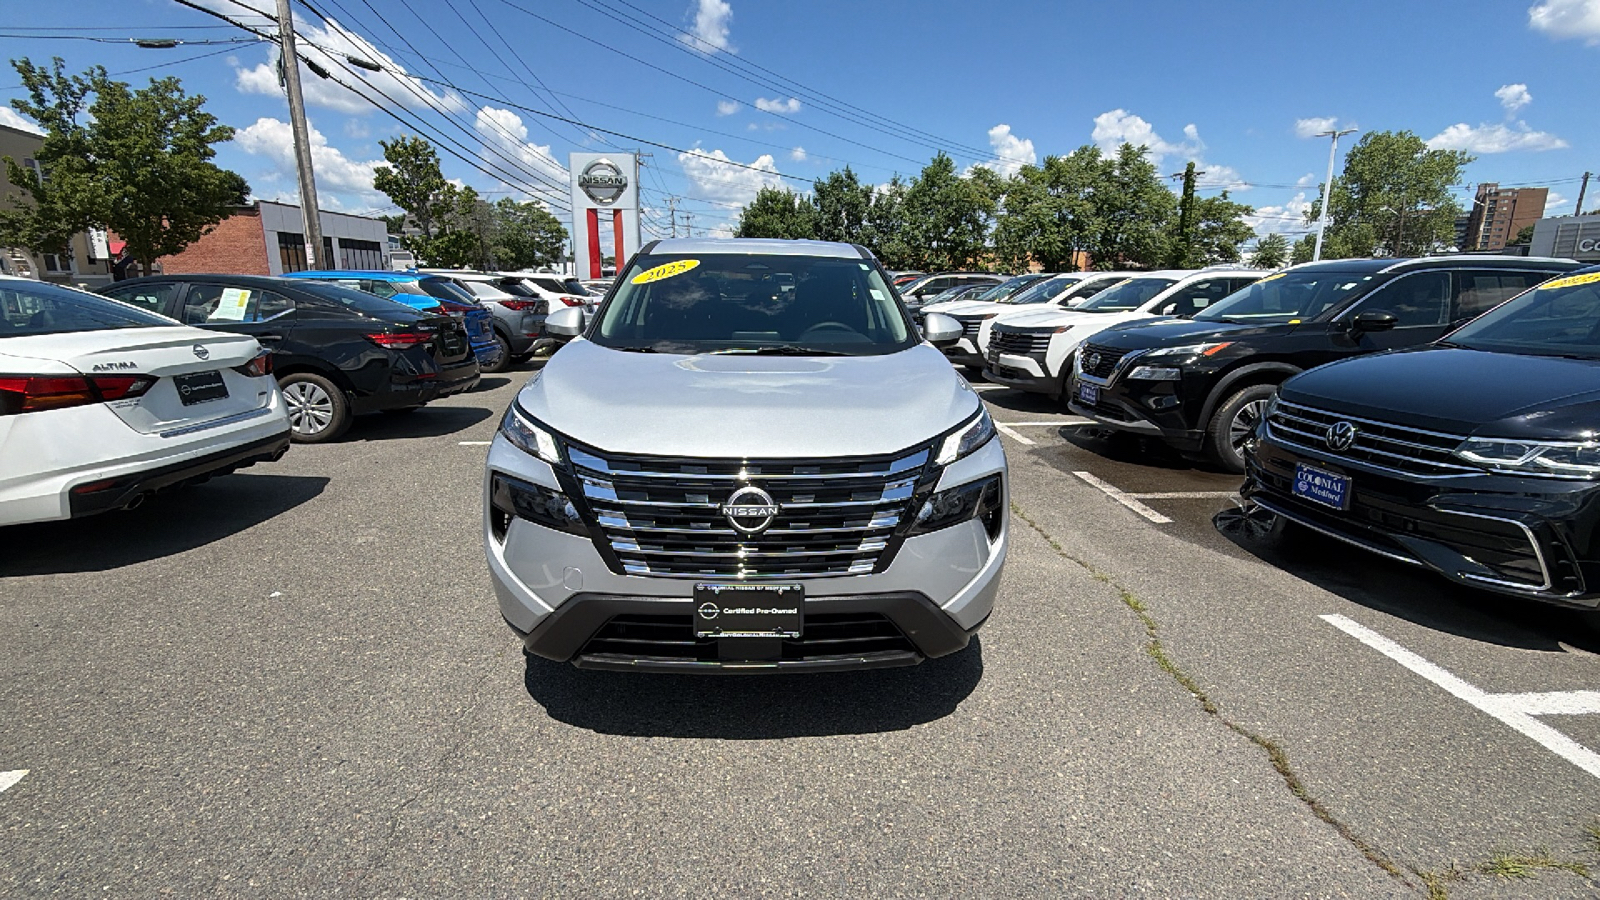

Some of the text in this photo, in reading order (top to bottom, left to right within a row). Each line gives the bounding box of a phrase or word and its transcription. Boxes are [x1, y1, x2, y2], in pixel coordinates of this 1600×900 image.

[582, 176, 623, 185] NISSAN
[646, 262, 687, 281] 2025
[92, 361, 138, 372] ALTIMA
[1298, 471, 1343, 493] COLONIAL
[1310, 485, 1341, 502] Medford
[723, 507, 778, 516] NISSAN
[723, 607, 798, 615] Certified Pre-Owned
